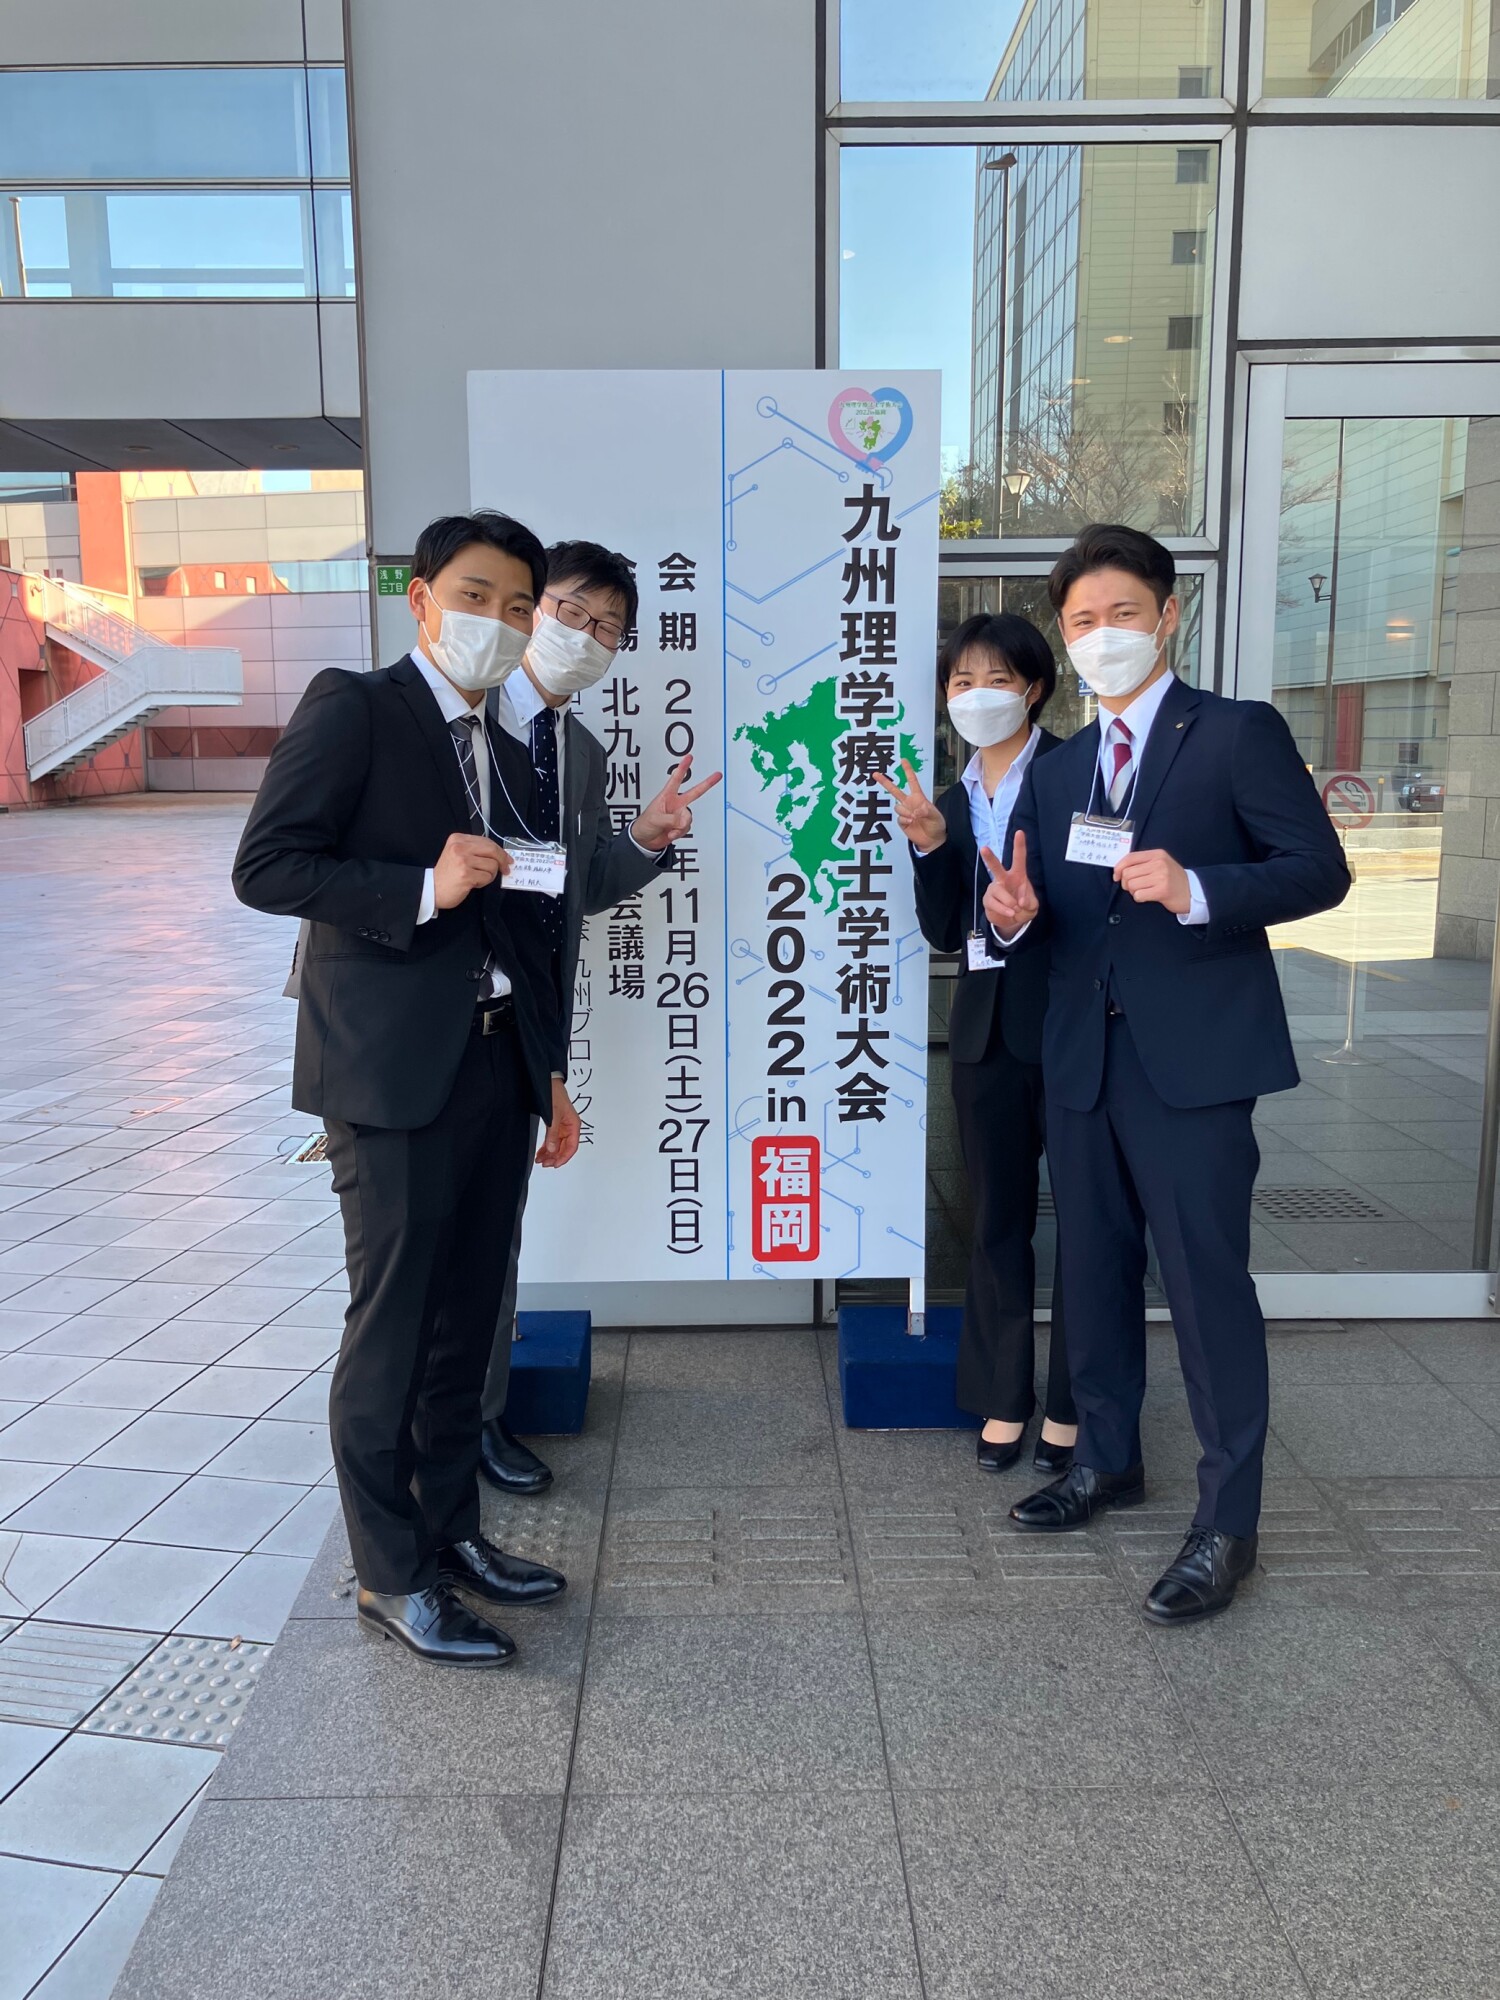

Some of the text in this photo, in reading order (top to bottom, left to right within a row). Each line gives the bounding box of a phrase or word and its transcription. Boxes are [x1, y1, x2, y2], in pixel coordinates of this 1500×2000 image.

[379, 569, 404, 580] 浅野
[380, 582, 404, 593] 三丁目
[602, 677, 646, 1000] 北九州国会議場
[835, 483, 902, 1123] 九州理学療法士学術大会
[656, 678, 711, 1254] 20年11月26日(土)27日(日)
[758, 1146, 812, 1253] 福岡
